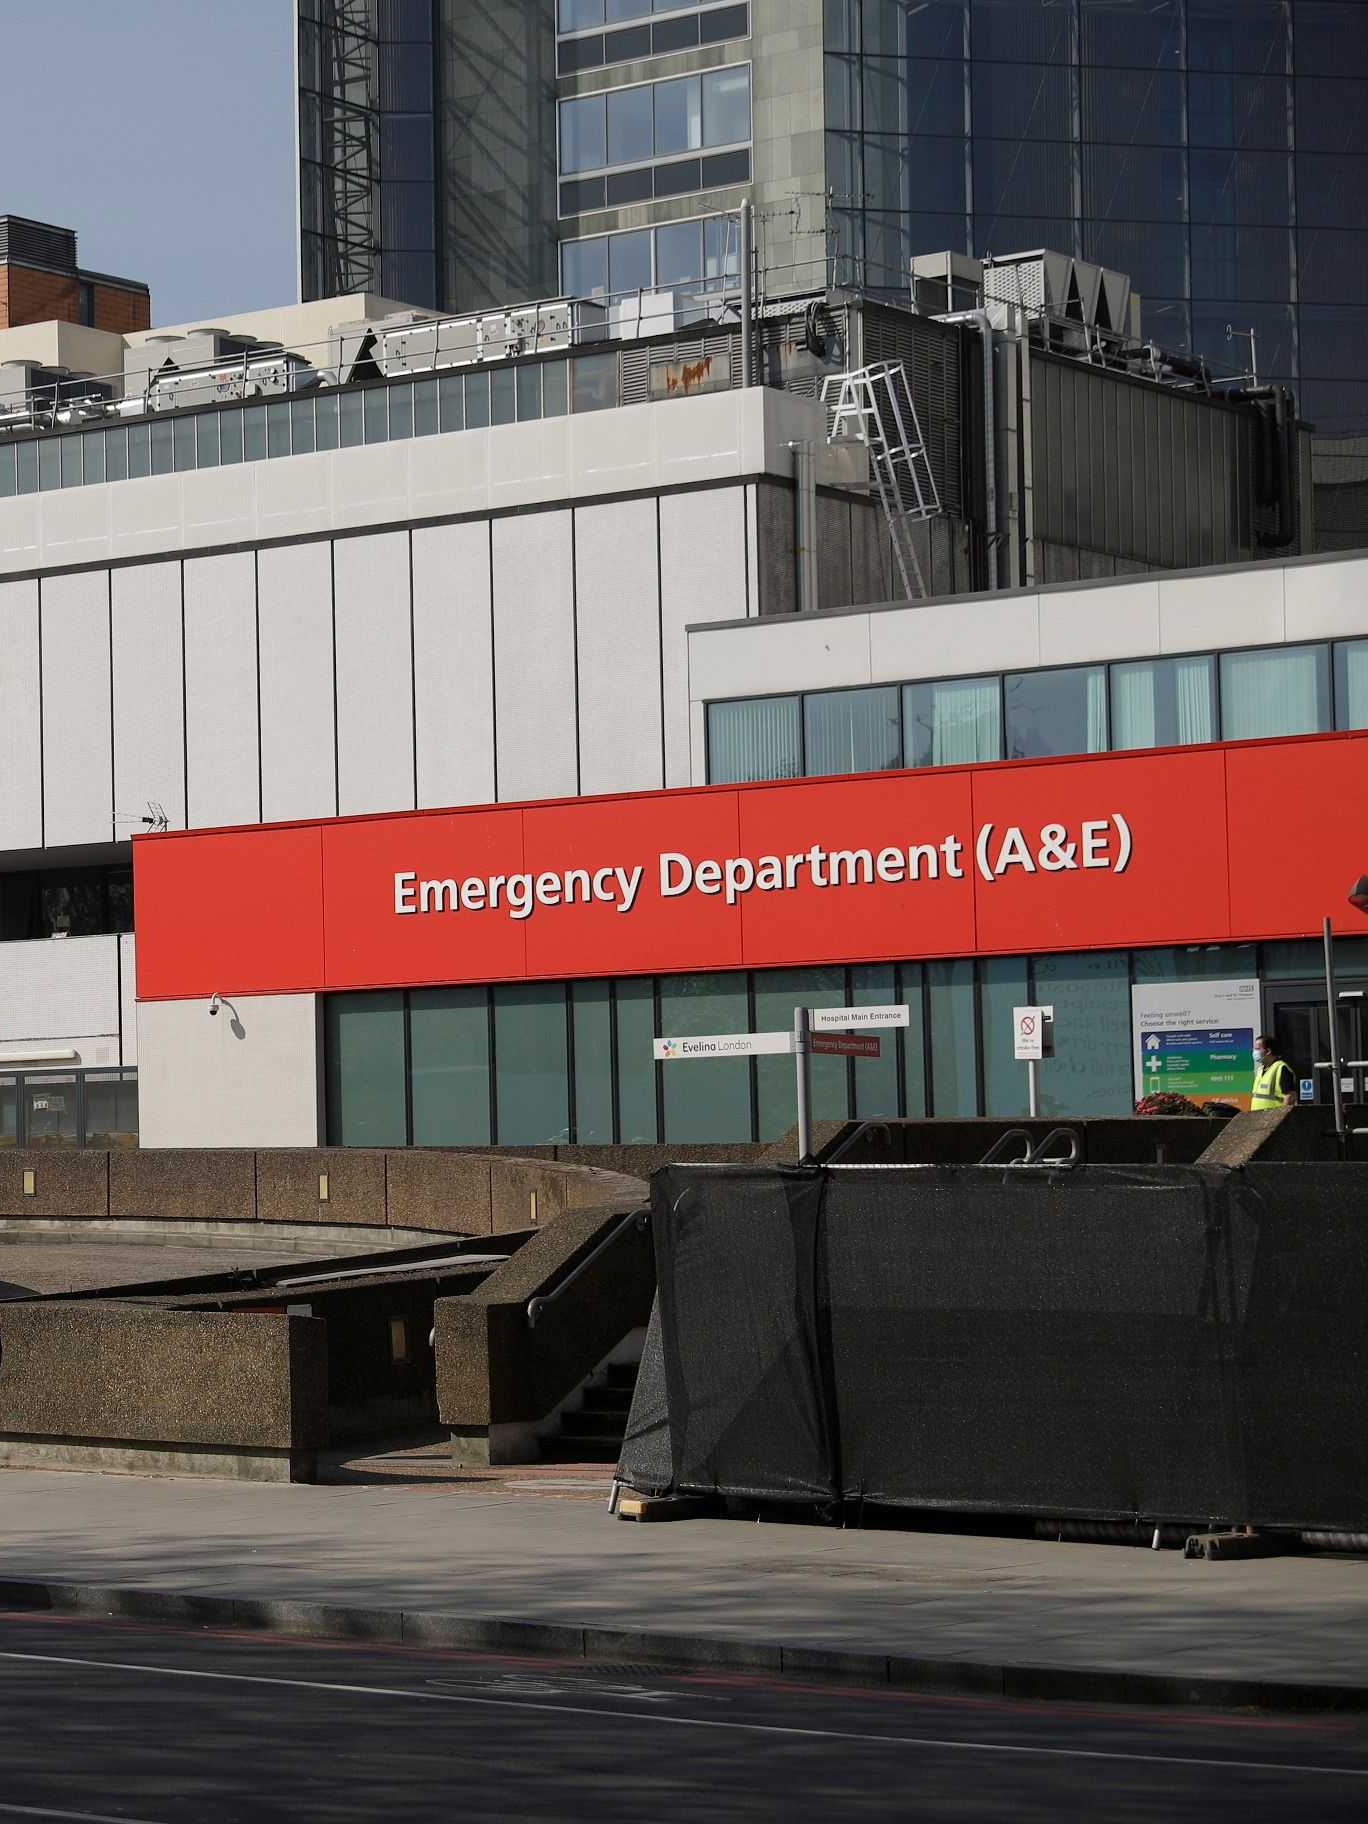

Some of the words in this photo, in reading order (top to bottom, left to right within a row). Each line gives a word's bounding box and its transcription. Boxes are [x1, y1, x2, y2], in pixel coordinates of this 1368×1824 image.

[393, 865, 643, 919] Emergency
[659, 834, 963, 904] Department
[976, 813, 1132, 881] (A&E)
[821, 1014, 850, 1023] Hospital
[852, 1013, 868, 1021] Main
[870, 1012, 902, 1020] Entrance
[1165, 1010, 1190, 1018] unwell?
[682, 1042, 716, 1053] Evelina
[718, 1040, 752, 1051] London
[812, 1038, 838, 1050] Emergency
[838, 1040, 864, 1051] Department
[864, 1042, 878, 1052] (A&E)
